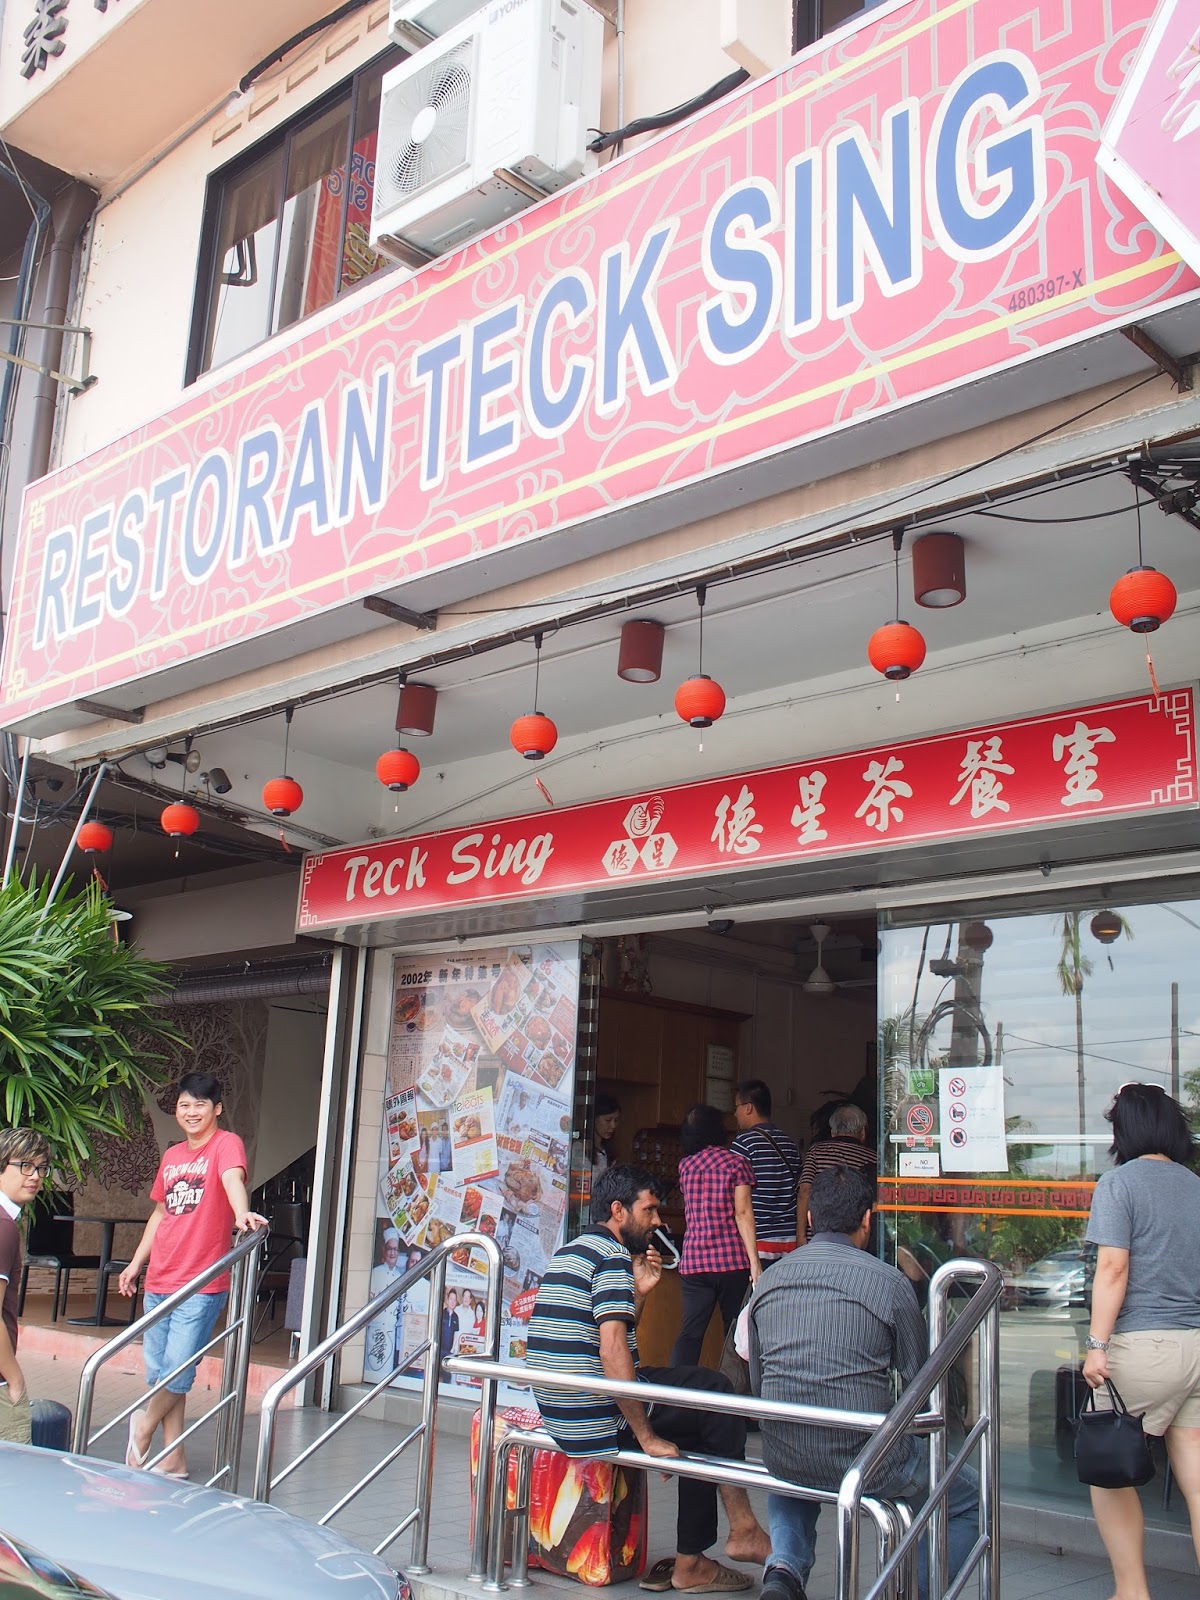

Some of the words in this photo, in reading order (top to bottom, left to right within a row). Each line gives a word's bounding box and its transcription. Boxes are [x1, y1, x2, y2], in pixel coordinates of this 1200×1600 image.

[1008, 268, 1084, 313] 480397-X
[33, 362, 395, 650] RESTORAN
[411, 216, 680, 489] TECK
[698, 49, 1044, 366] SING
[710, 720, 1117, 855] 德星茶餐室
[343, 846, 428, 902] Teck
[446, 832, 554, 885] Sing
[401, 970, 433, 985] 2002年
